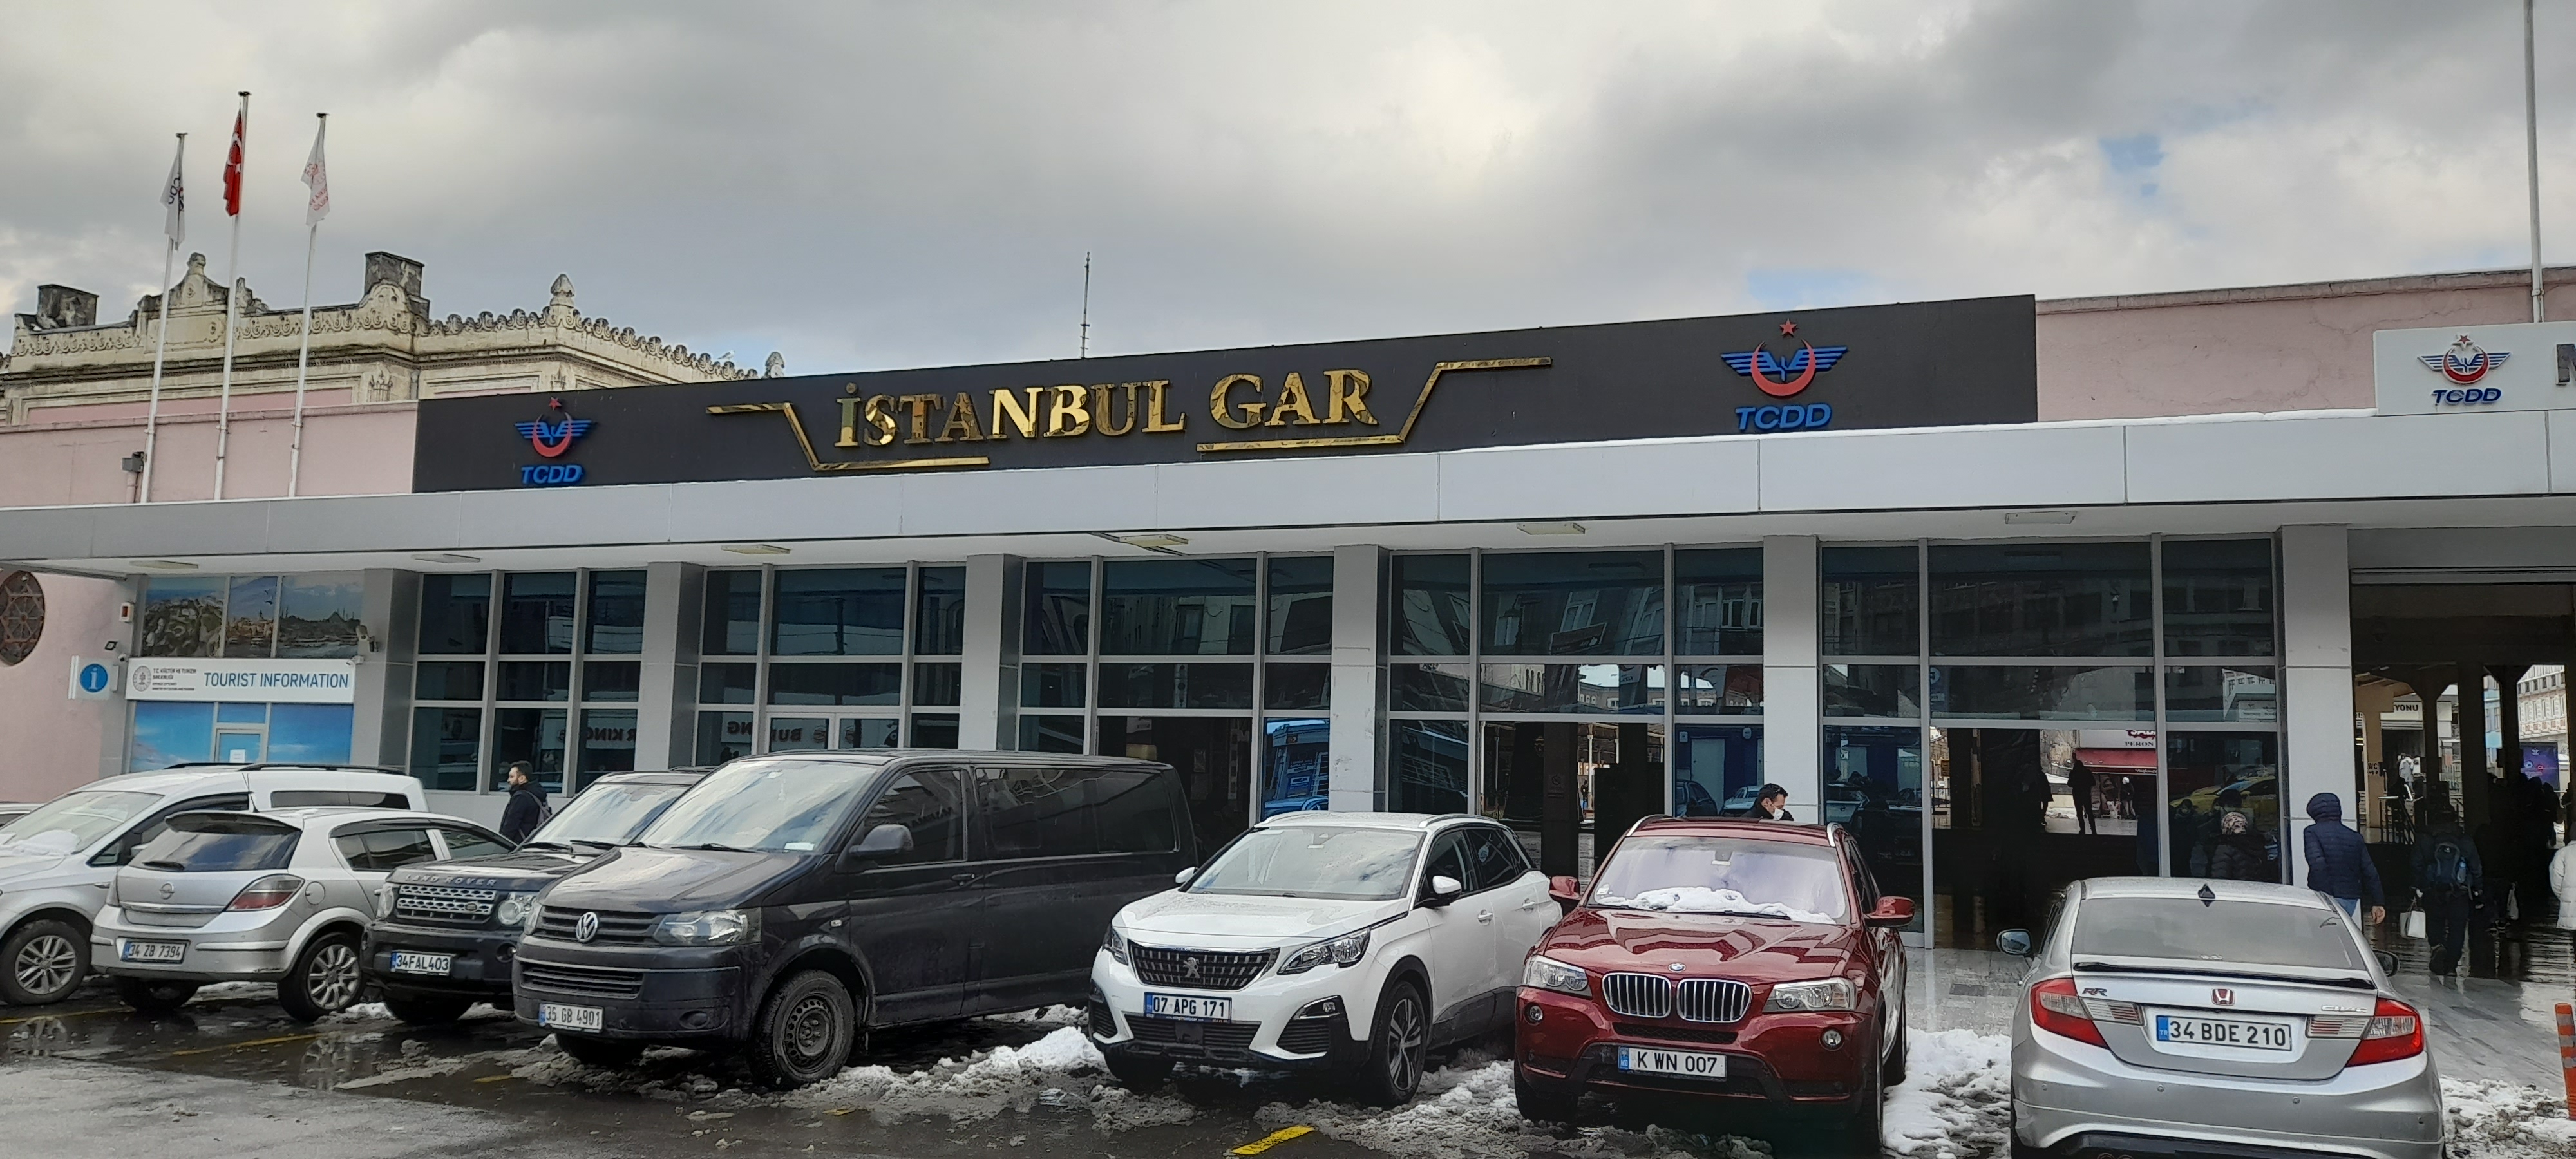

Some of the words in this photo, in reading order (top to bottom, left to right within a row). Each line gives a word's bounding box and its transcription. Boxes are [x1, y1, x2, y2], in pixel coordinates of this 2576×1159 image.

[2432, 388, 2503, 406] TCDD
[835, 379, 1186, 447] İSTANBUL
[1209, 368, 1379, 429] GAR
[1735, 402, 1833, 431] TCDD
[521, 464, 583, 484] TCDD
[204, 672, 257, 687] TOURIST
[260, 673, 348, 688] INFORMATION
[405, 874, 439, 883] LAND
[444, 876, 498, 887] ROVER
[129, 944, 140, 957] 34
[143, 945, 156, 957] ZB
[158, 945, 181, 958] 7394
[546, 1006, 556, 1021] 35
[561, 1008, 573, 1023] GB
[576, 1009, 600, 1027] 4901
[1153, 997, 1168, 1013] 07
[1173, 998, 1197, 1015] APG
[1203, 1001, 1224, 1017] 171
[2170, 1021, 2195, 1039] 34
[2201, 1022, 2240, 1042] BDE
[2247, 1026, 2286, 1046] 210
[1637, 1051, 1648, 1069] K
[1654, 1052, 1678, 1071] WN
[1685, 1055, 1718, 1074] 007
